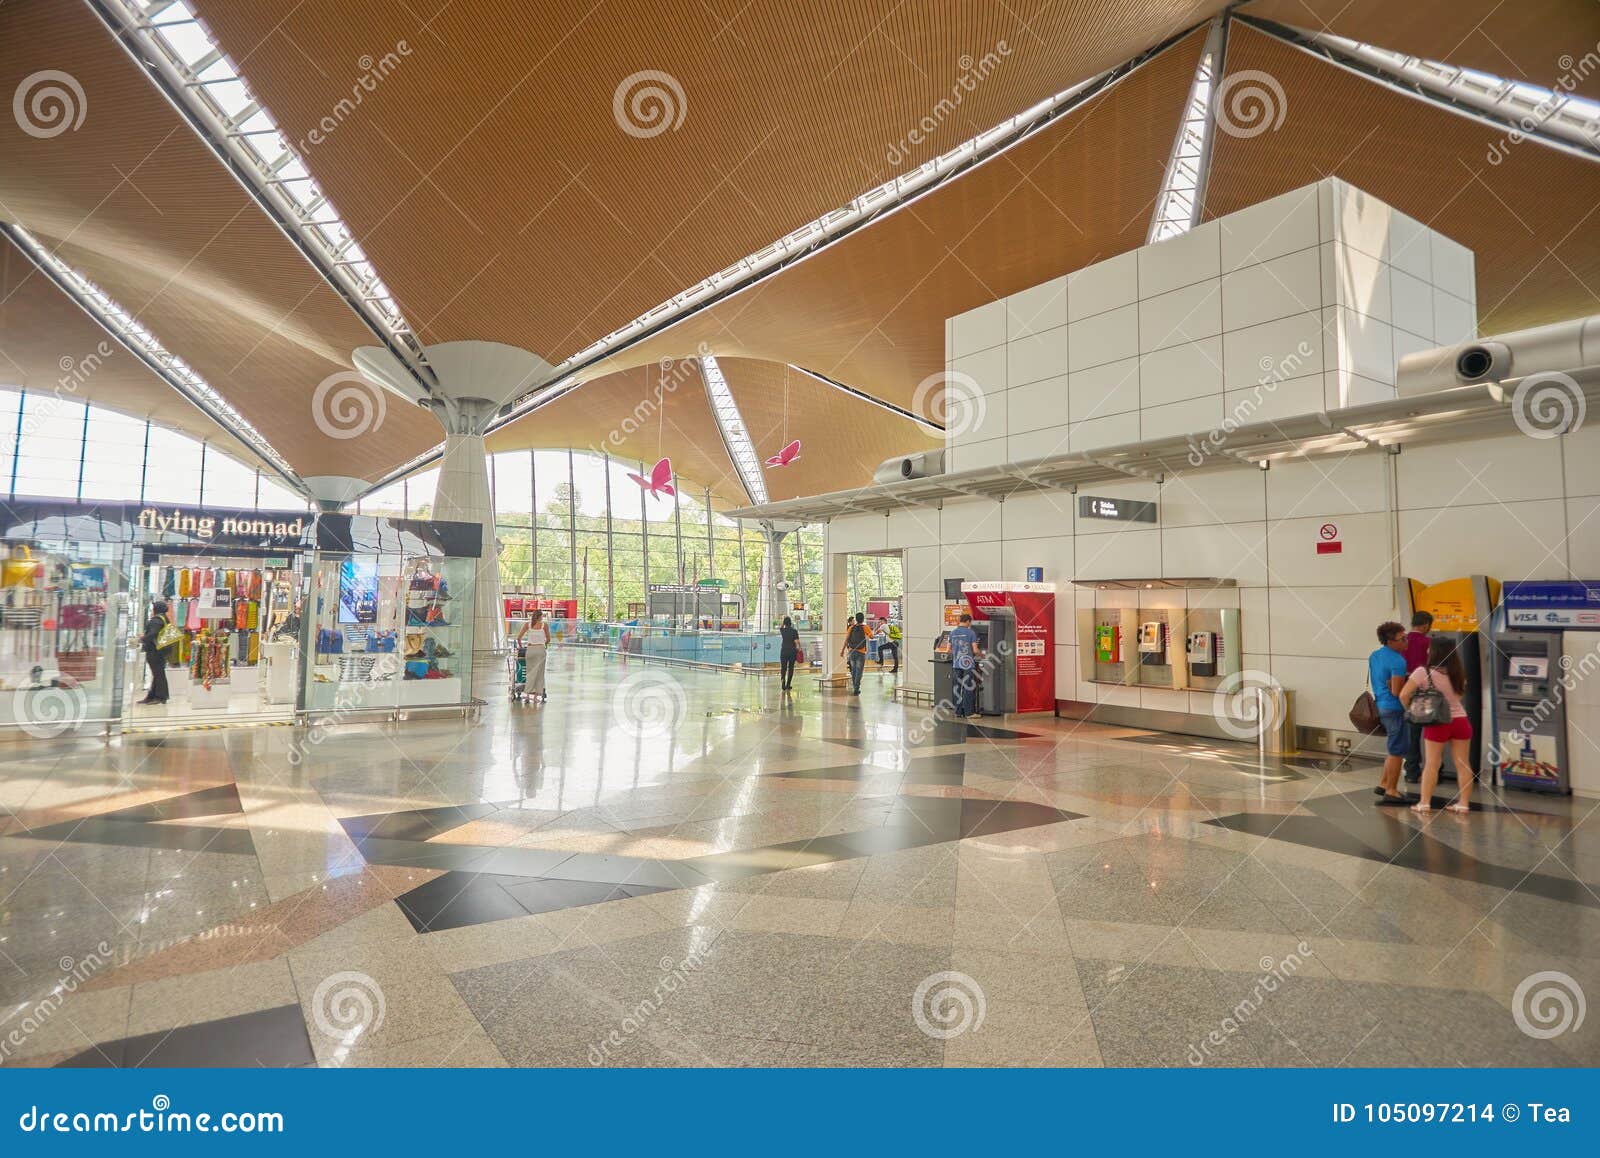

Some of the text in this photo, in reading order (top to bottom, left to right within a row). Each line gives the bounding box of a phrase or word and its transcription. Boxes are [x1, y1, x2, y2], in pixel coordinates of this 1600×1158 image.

[137, 507, 302, 538] flying nomad
[976, 595, 994, 604] ATM
[1514, 613, 1538, 622] VISA
